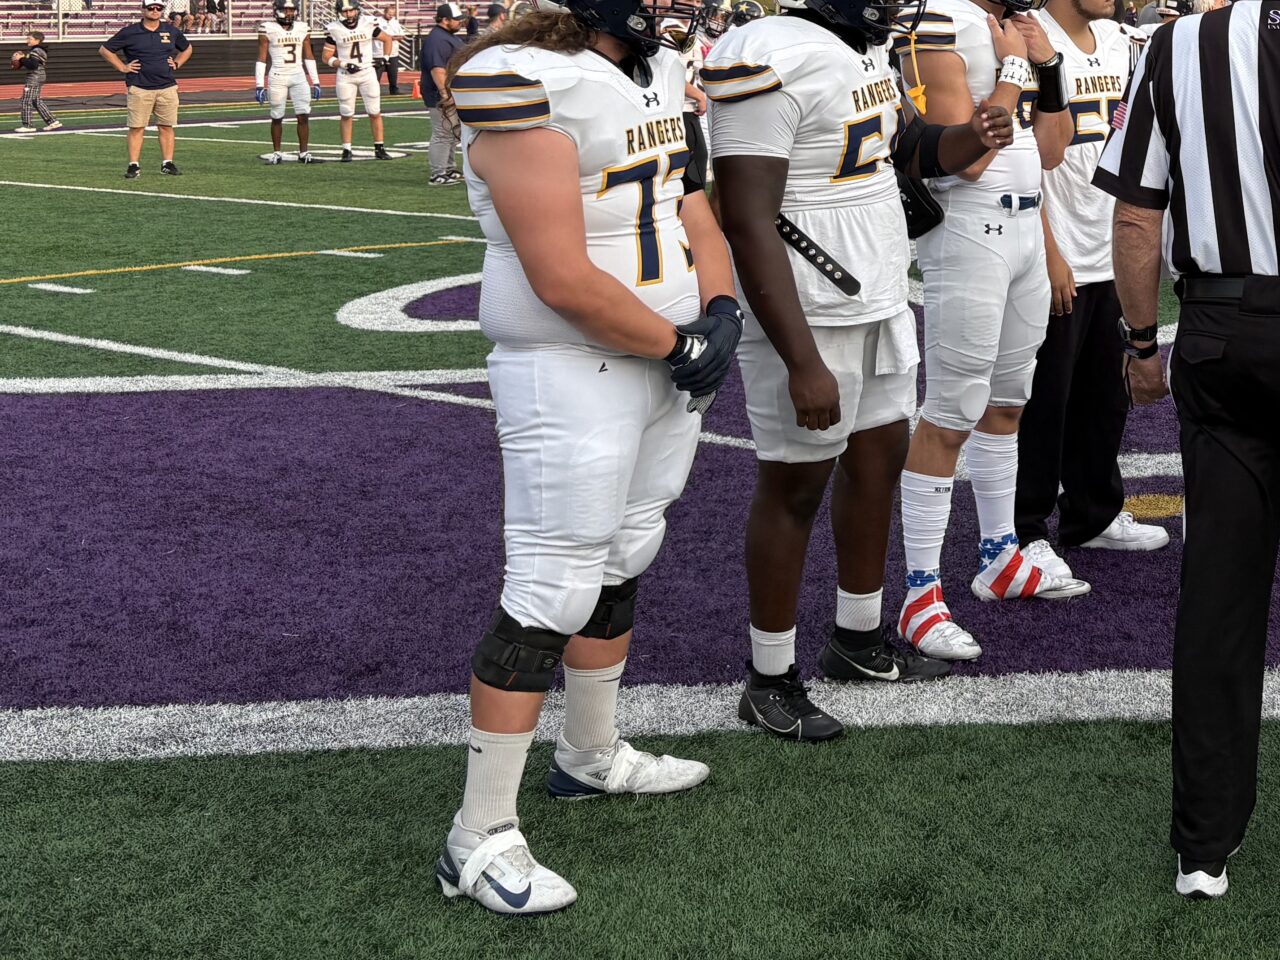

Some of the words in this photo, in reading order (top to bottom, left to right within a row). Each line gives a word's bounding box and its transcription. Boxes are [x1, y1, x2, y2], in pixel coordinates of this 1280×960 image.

[284, 43, 296, 63] 3
[350, 41, 362, 63] 4
[852, 78, 897, 114] RANGERS
[1075, 75, 1122, 96] RANGERS
[625, 116, 684, 156] RANGERS
